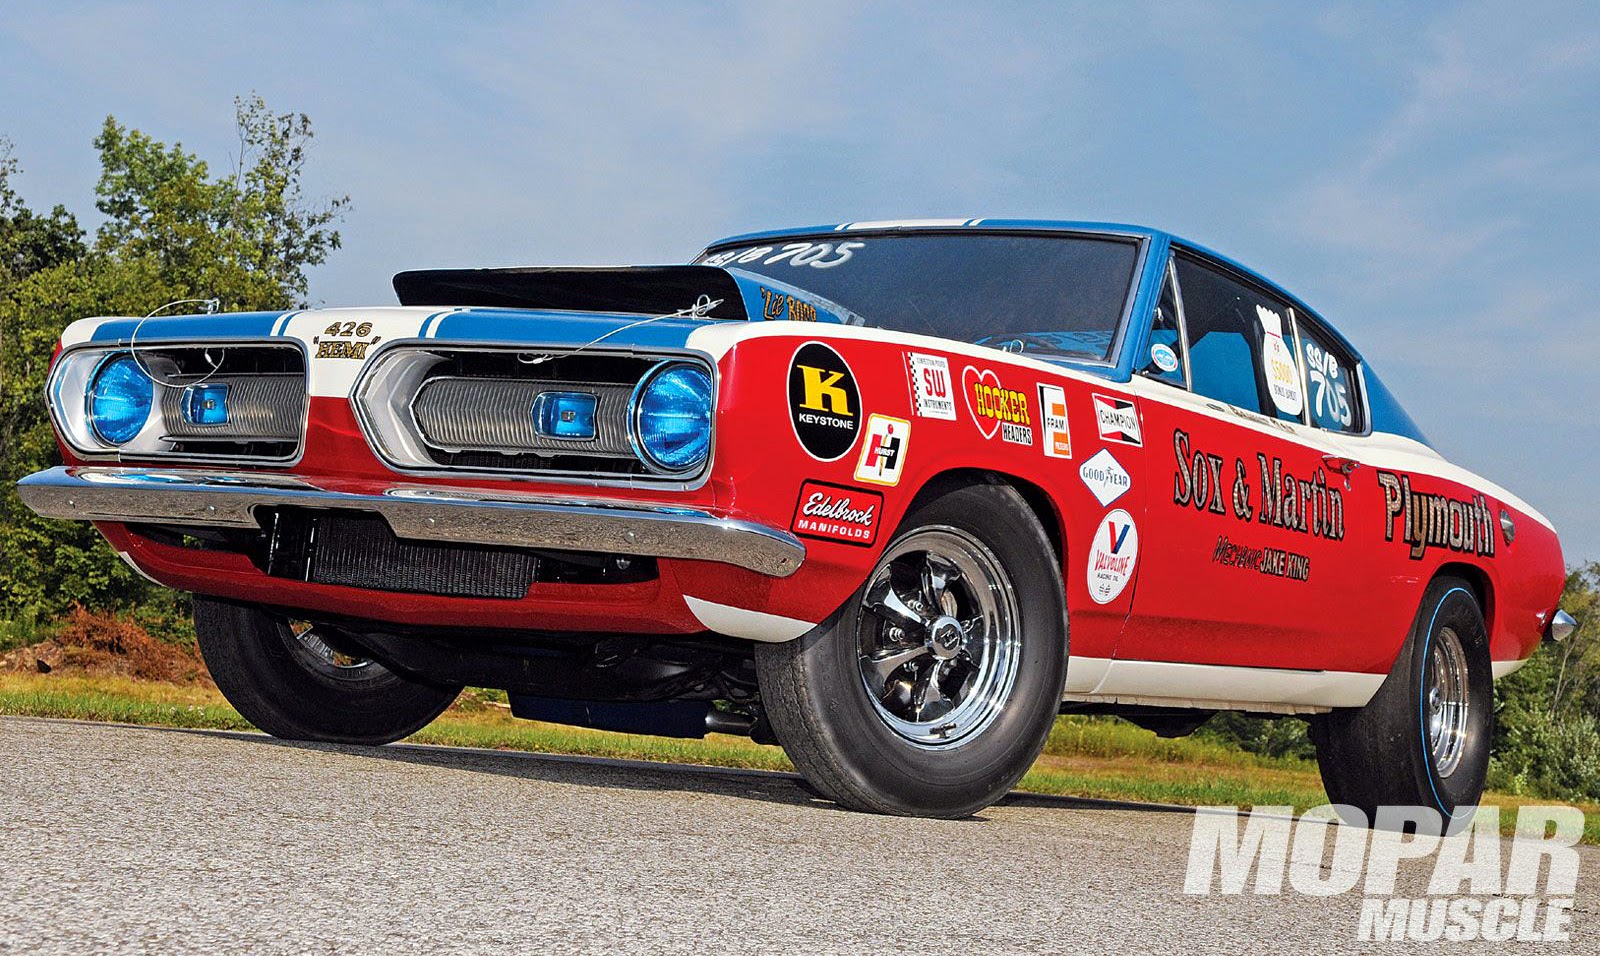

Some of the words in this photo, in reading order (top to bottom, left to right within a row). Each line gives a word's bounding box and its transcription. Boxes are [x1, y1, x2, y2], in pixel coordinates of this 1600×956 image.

[763, 243, 866, 269] 705
[324, 321, 373, 337] 426
[1306, 343, 1338, 379] SS/B
[797, 364, 853, 416] K
[923, 367, 946, 398] SW
[974, 382, 1031, 426] HOOKER
[1310, 370, 1352, 427] 705
[799, 413, 854, 430] KEYSTONE
[1002, 424, 1032, 445] HEADERS
[1047, 417, 1064, 430] FRAM
[1100, 409, 1137, 431] CHAMPION
[874, 446, 895, 457] HURST
[1173, 428, 1226, 515] Sox
[1233, 458, 1252, 522] &
[1257, 452, 1345, 539] Martin
[803, 492, 875, 527] Edelbrock
[1376, 470, 1495, 560] Plymouth
[798, 519, 871, 539] MANIFOLDS
[1109, 521, 1130, 554] V
[1094, 549, 1130, 577] VALVOLINE
[1260, 547, 1286, 577] JAKE
[1286, 552, 1310, 582] KING
